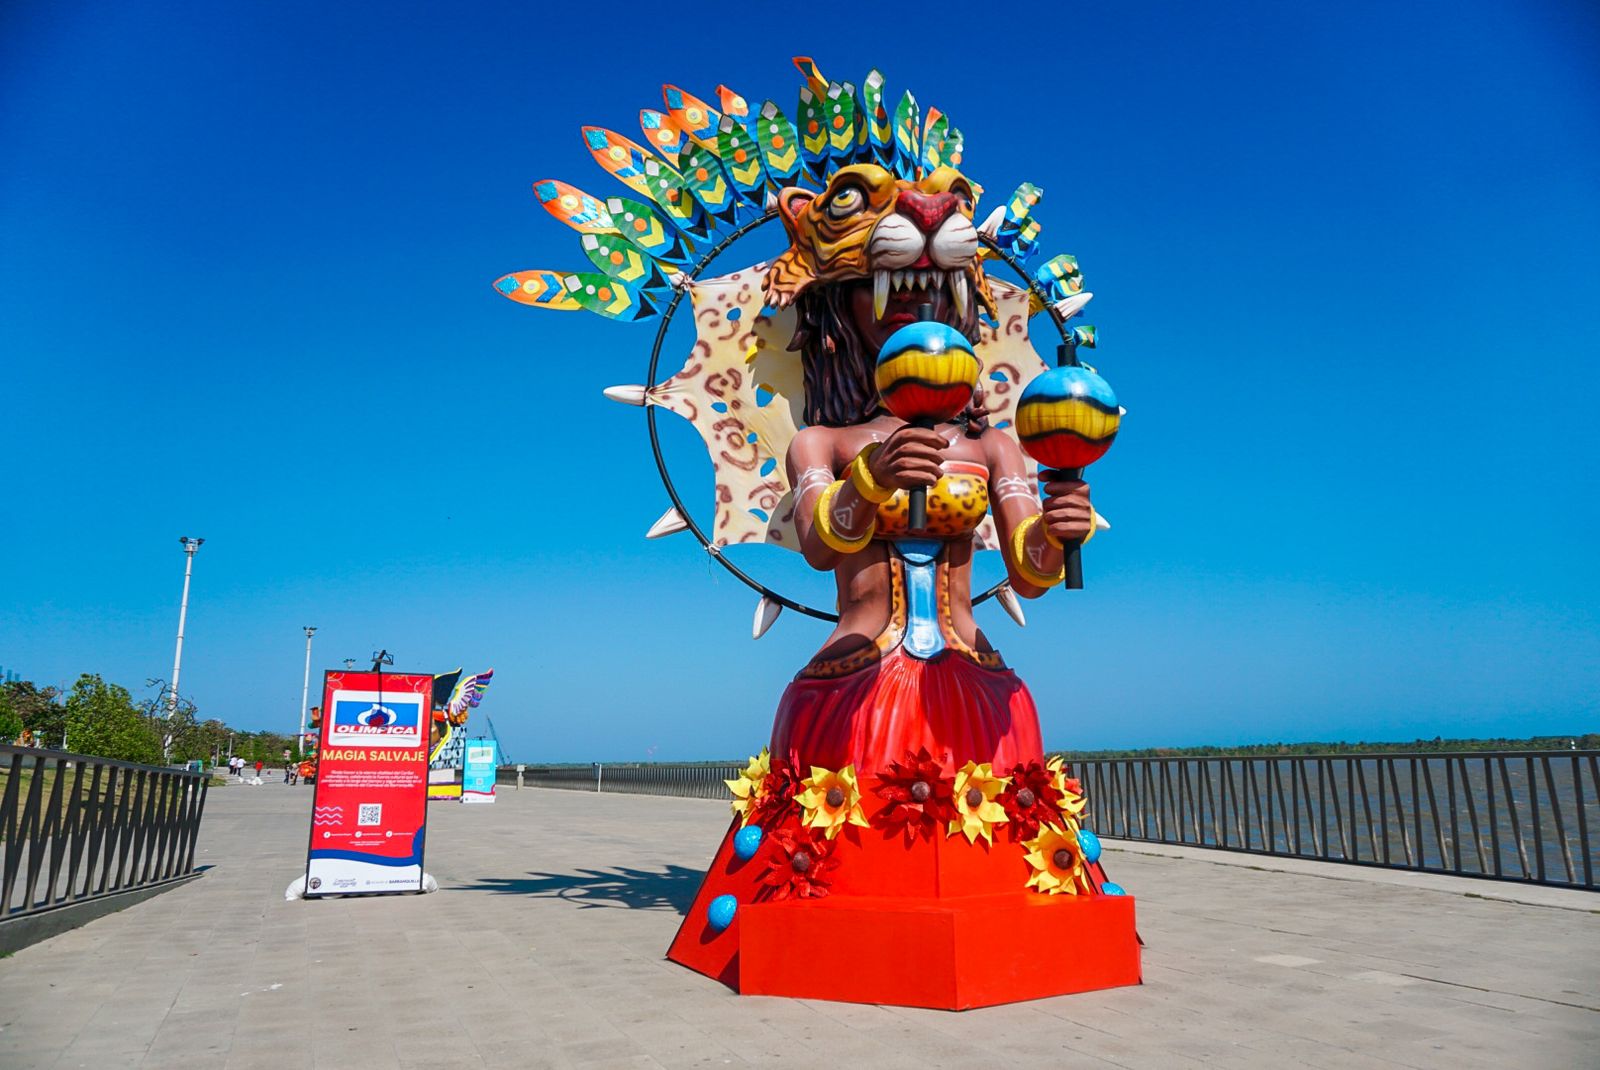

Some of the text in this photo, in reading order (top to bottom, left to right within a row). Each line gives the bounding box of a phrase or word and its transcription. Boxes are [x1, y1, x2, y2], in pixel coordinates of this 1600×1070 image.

[336, 725, 415, 735] OLIMPICA
[322, 750, 425, 762] MAGIA SALVAJE
